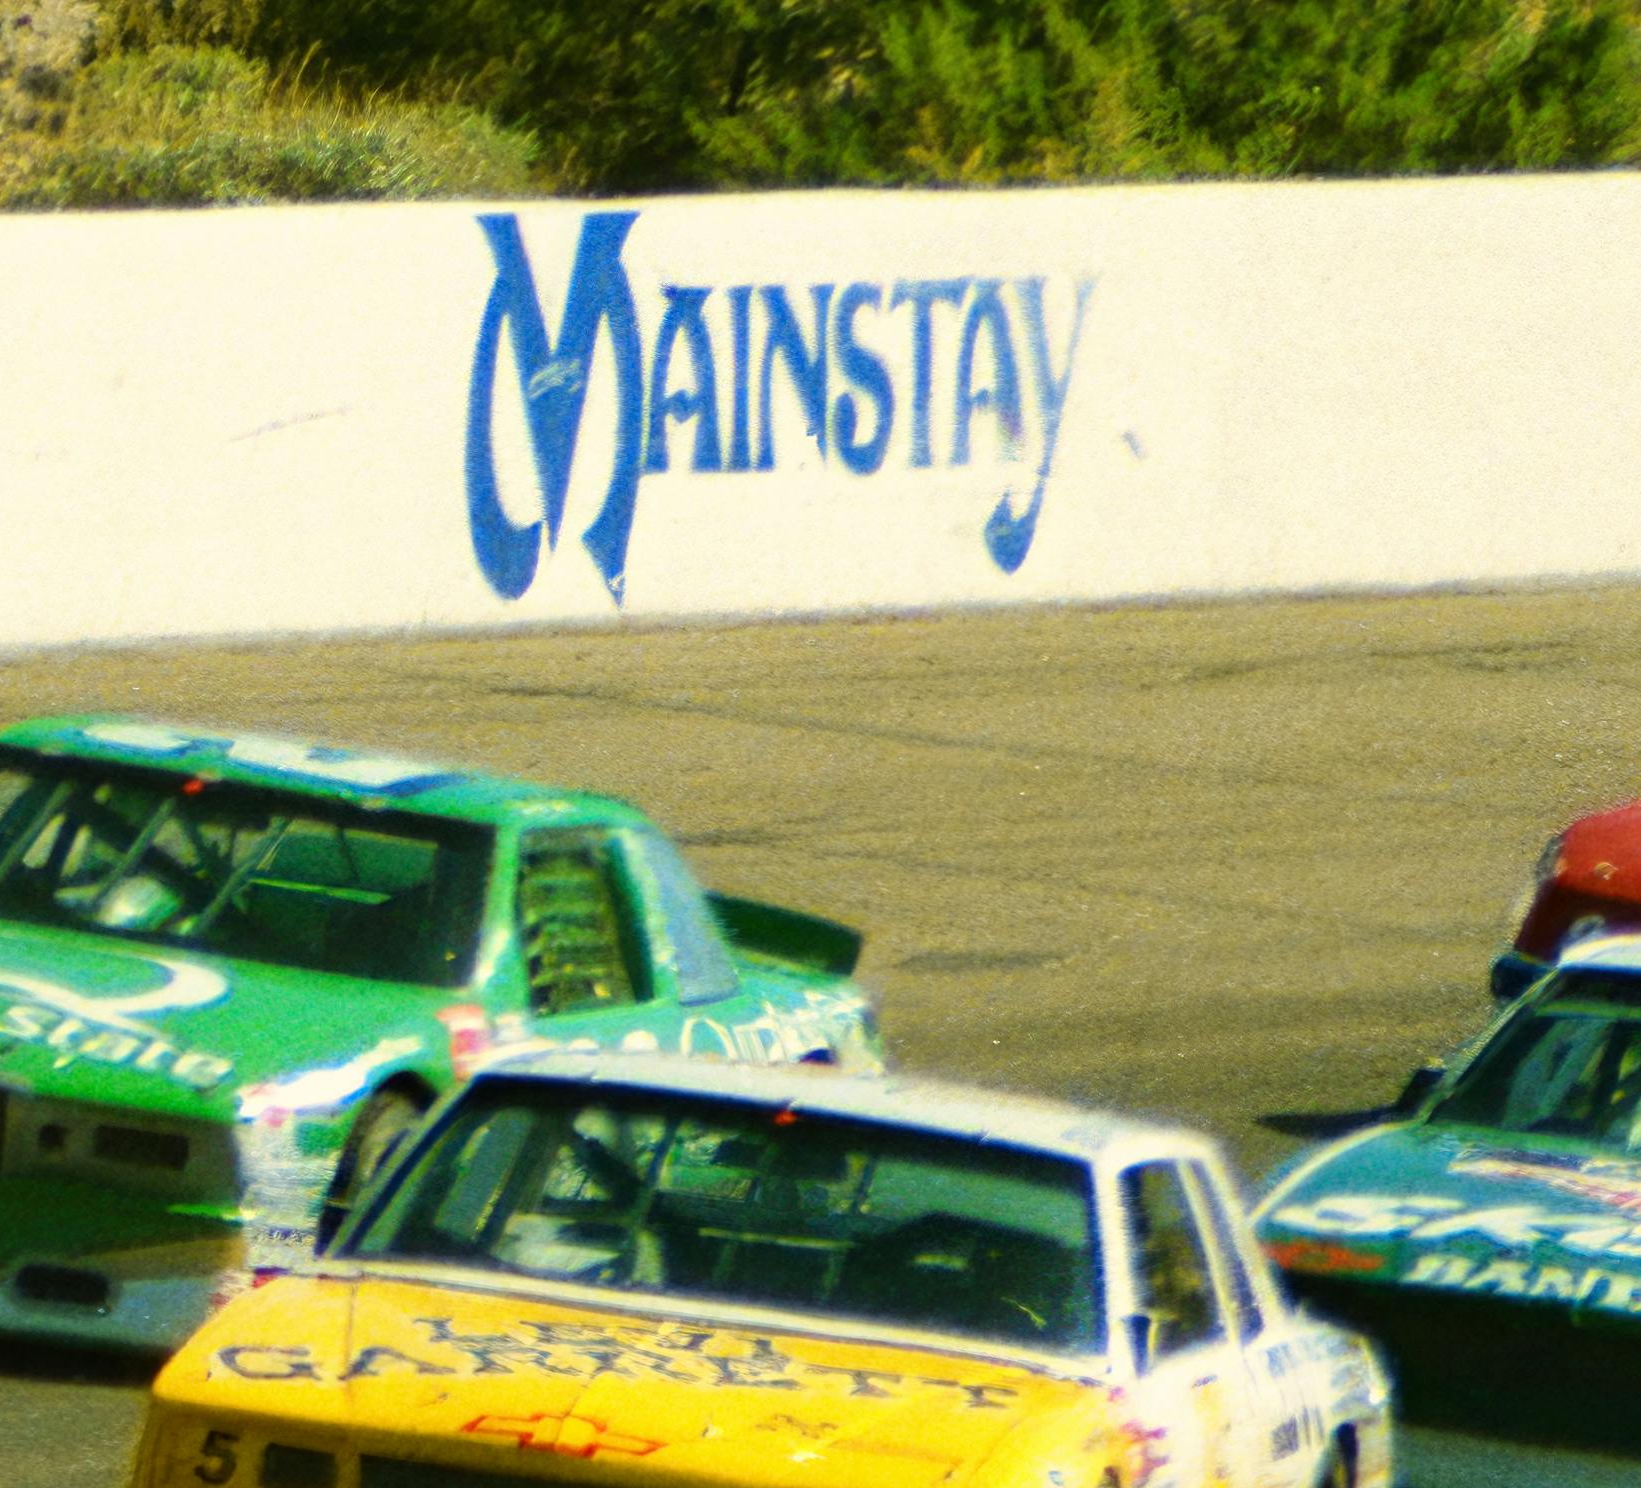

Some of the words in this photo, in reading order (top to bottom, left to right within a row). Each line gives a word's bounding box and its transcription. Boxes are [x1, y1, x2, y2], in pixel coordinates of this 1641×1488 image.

[464, 210, 1096, 608] MAINSTAY
[206, 1345, 1021, 1411] GARRETT
[194, 1429, 239, 1486] 5
